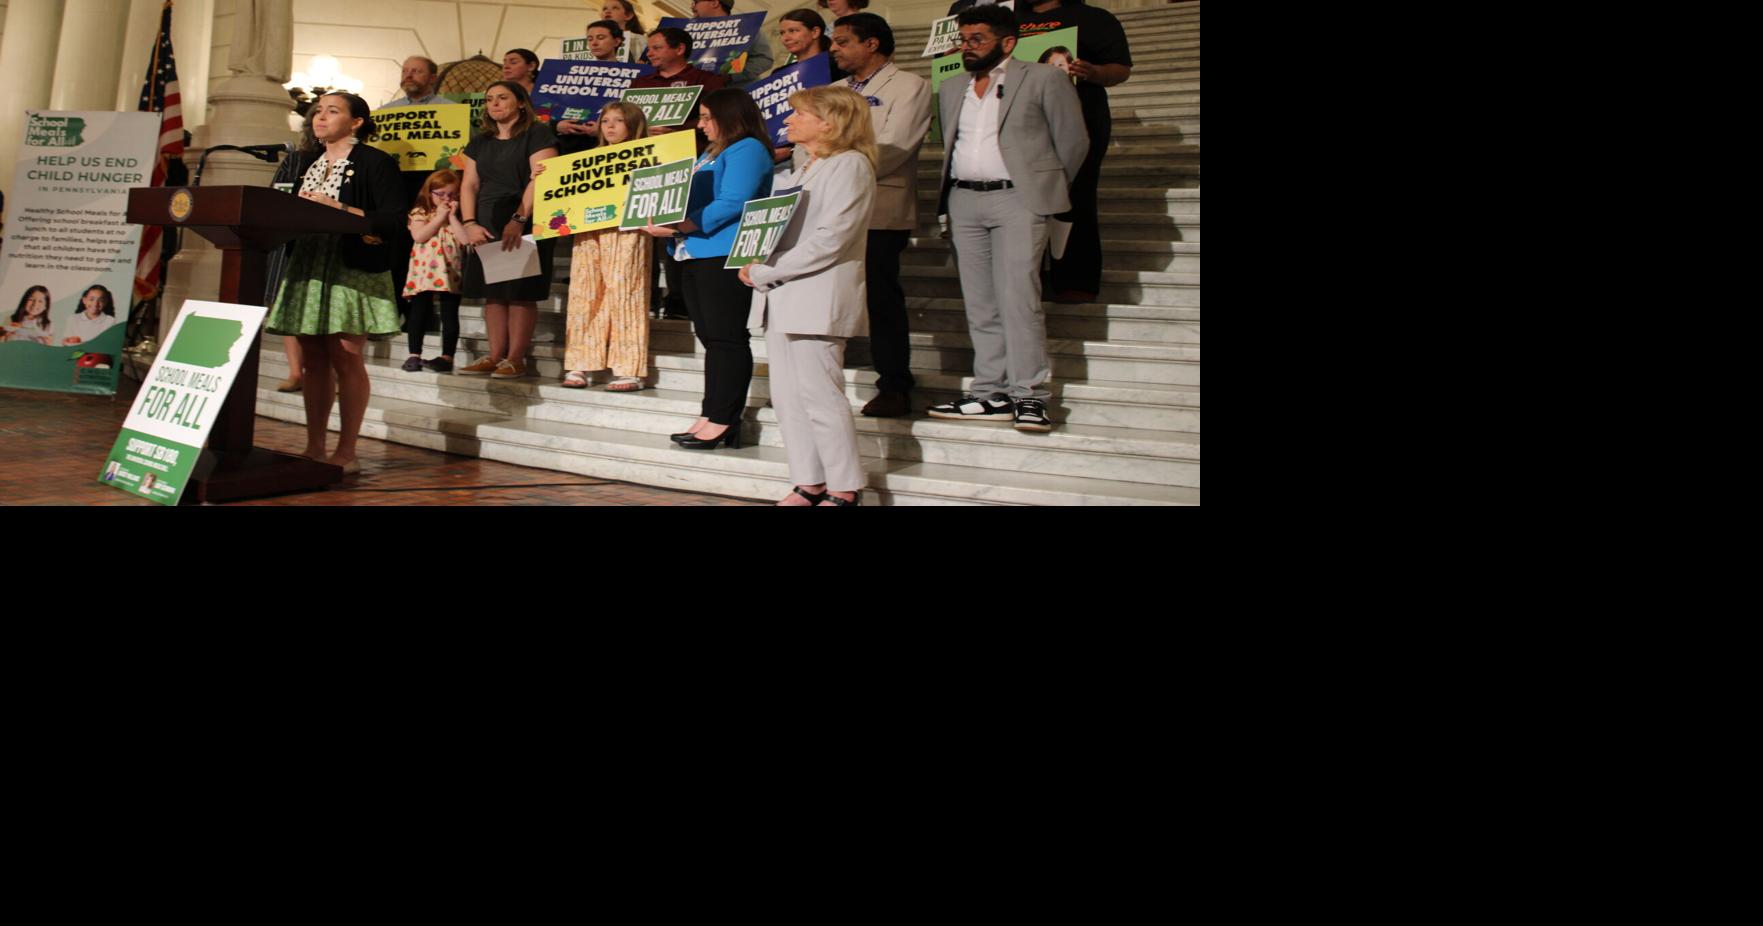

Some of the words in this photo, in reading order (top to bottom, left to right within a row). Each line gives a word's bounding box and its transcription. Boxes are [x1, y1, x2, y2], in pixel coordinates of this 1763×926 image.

[684, 19, 741, 31] SUPPORT
[937, 22, 943, 34] 1
[692, 28, 739, 40] IVERSAL
[564, 41, 570, 52] 1
[573, 40, 584, 51] IN
[709, 34, 750, 48] MEALS
[569, 66, 640, 78] SUPPORT
[940, 63, 960, 72] FEED
[556, 75, 632, 88] UNIVERSA
[752, 70, 799, 100] PPORT
[538, 84, 598, 96] SCHOOL
[756, 82, 806, 110] VERSAL
[626, 94, 659, 104] SCHOOL
[660, 92, 694, 102] MEALS
[652, 103, 684, 122] ALL
[32, 116, 68, 127] School
[377, 120, 442, 132] IVERSAL
[30, 126, 66, 136] Meals
[369, 132, 401, 142] OOL
[406, 130, 461, 140] MEALS
[37, 156, 76, 166] HELP
[82, 156, 100, 167] US
[106, 158, 138, 168] END
[572, 144, 655, 170] SUPPORT
[27, 170, 73, 181] CHILD
[78, 172, 143, 183] HUNGER
[560, 156, 662, 186] UNIVERSAL
[633, 174, 664, 192] SCHOOL
[664, 168, 689, 186] MEALS
[544, 178, 614, 200] SCHOOL
[627, 191, 659, 220] FOR
[658, 187, 683, 216] ALL
[743, 208, 768, 227] SCHOOL
[768, 204, 794, 223] MEALS
[732, 228, 762, 258] FOR
[155, 366, 189, 386] SCHOOL
[188, 372, 222, 392] MEALS
[138, 386, 176, 421] FOR
[169, 393, 208, 430] ALL
